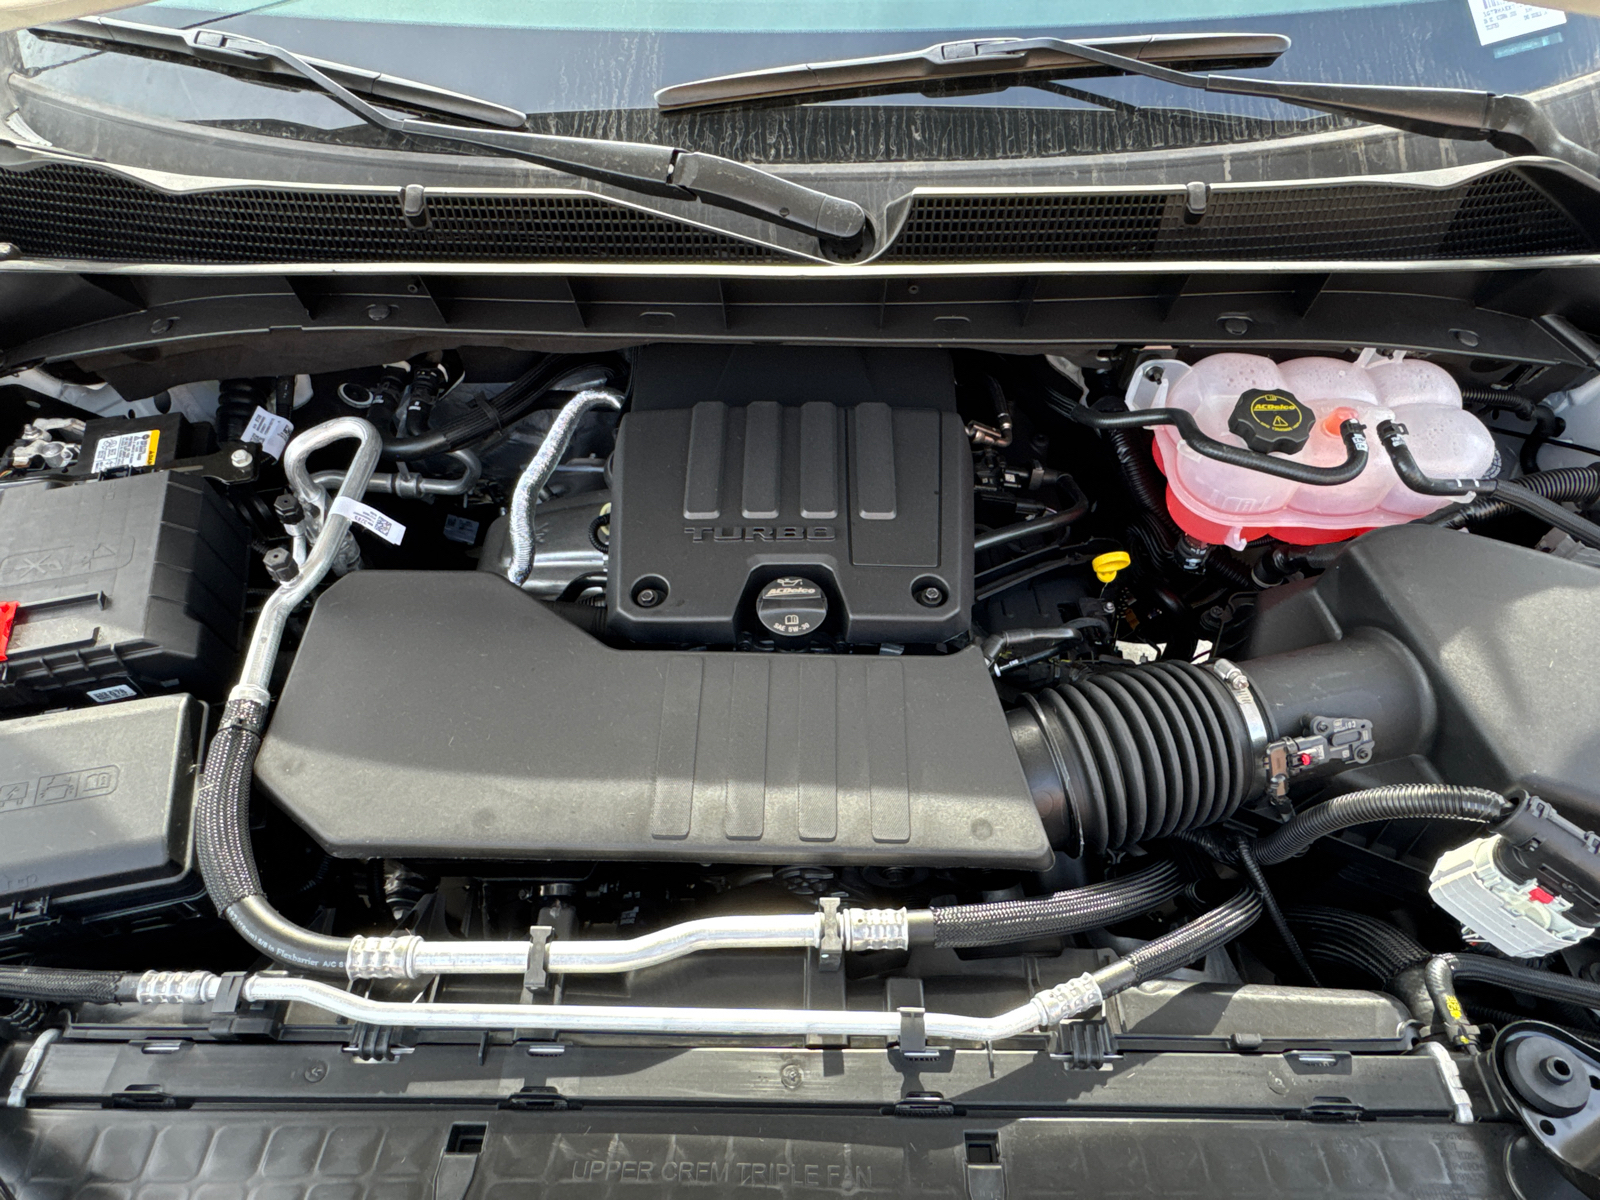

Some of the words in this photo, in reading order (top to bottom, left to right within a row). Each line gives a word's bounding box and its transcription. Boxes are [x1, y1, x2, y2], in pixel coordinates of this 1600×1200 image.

[1253, 403, 1297, 411] ACDelco
[684, 526, 836, 543] TURBO
[765, 587, 816, 597] ACDelco
[773, 622, 786, 632] SAE
[788, 622, 810, 633] 5W-30
[276, 947, 320, 967] Flexbarrier
[322, 960, 337, 968] A/C
[572, 1160, 654, 1182] UPPER
[736, 1162, 820, 1187] TRIPLE
[827, 1165, 873, 1189] FAN
